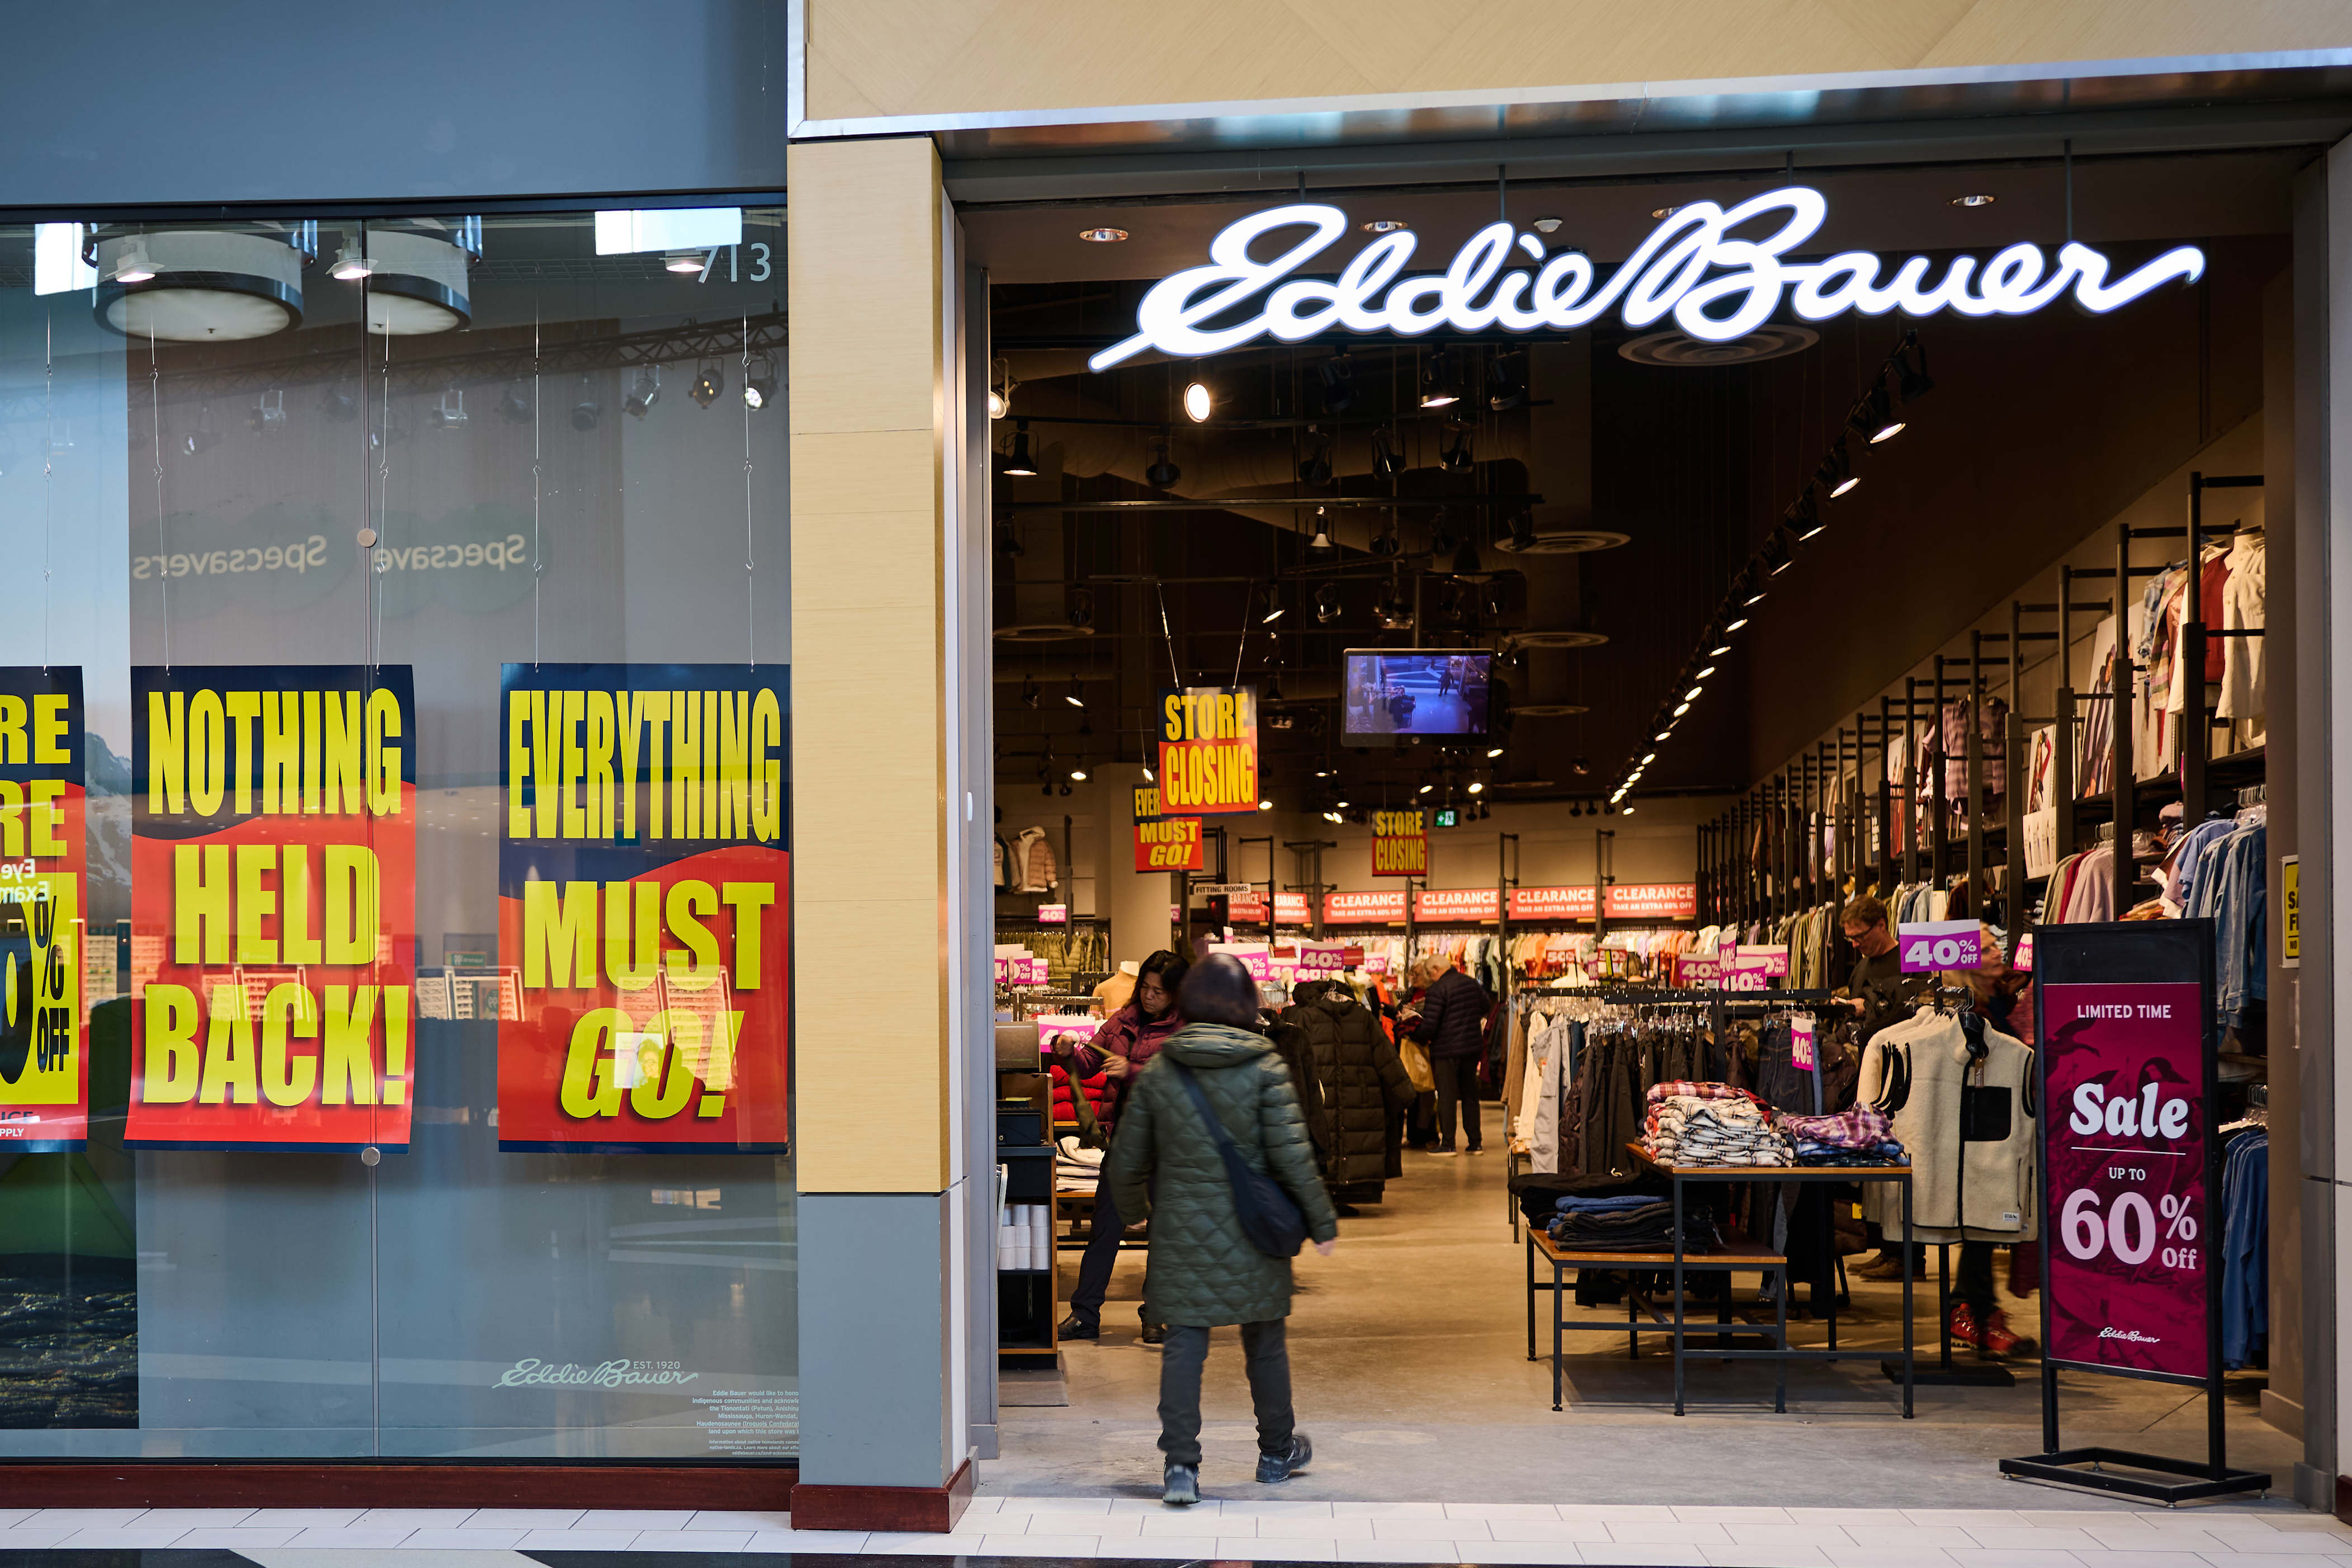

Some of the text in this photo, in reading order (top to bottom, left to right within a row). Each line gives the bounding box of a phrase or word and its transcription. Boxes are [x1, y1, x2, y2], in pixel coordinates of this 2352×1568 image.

[695, 242, 771, 284] 713
[1088, 185, 2206, 373] Eddie Bauer
[1165, 693, 1249, 741] STORE
[149, 688, 403, 817] NOTHING
[508, 688, 781, 843] EVERYTHING
[1165, 743, 1254, 806] CLOSING
[1140, 821, 1198, 843] MUST
[1376, 811, 1423, 836] STORE
[1149, 844, 1193, 866] GO!
[1376, 838, 1425, 871] CLOSING
[174, 844, 380, 965] HELD
[1331, 894, 1405, 908] CLEARANCE
[1422, 891, 1498, 905] CLEARANCE
[1517, 889, 1595, 904] CLEARANCE
[1613, 886, 1694, 901] CLEARANCE
[524, 880, 775, 991] MUST
[1302, 952, 1342, 967] 40%
[1905, 939, 1977, 967] 40% OFF
[1253, 969, 1266, 977] OFF
[2077, 1005, 2171, 1018] LIMITED TIME
[37, 1007, 69, 1073] OFF
[143, 983, 409, 1107] BACK!
[1792, 1036, 1811, 1064] 40%
[560, 1008, 745, 1120] GO!
[2070, 1081, 2189, 1139] Sale
[2108, 1167, 2146, 1181] UP TO
[2061, 1188, 2197, 1265] 60%
[2098, 1327, 2160, 1343] Eddie Bauer
[492, 1358, 698, 1388] Eddie Bauer
[633, 1361, 680, 1369] EST. 1920
